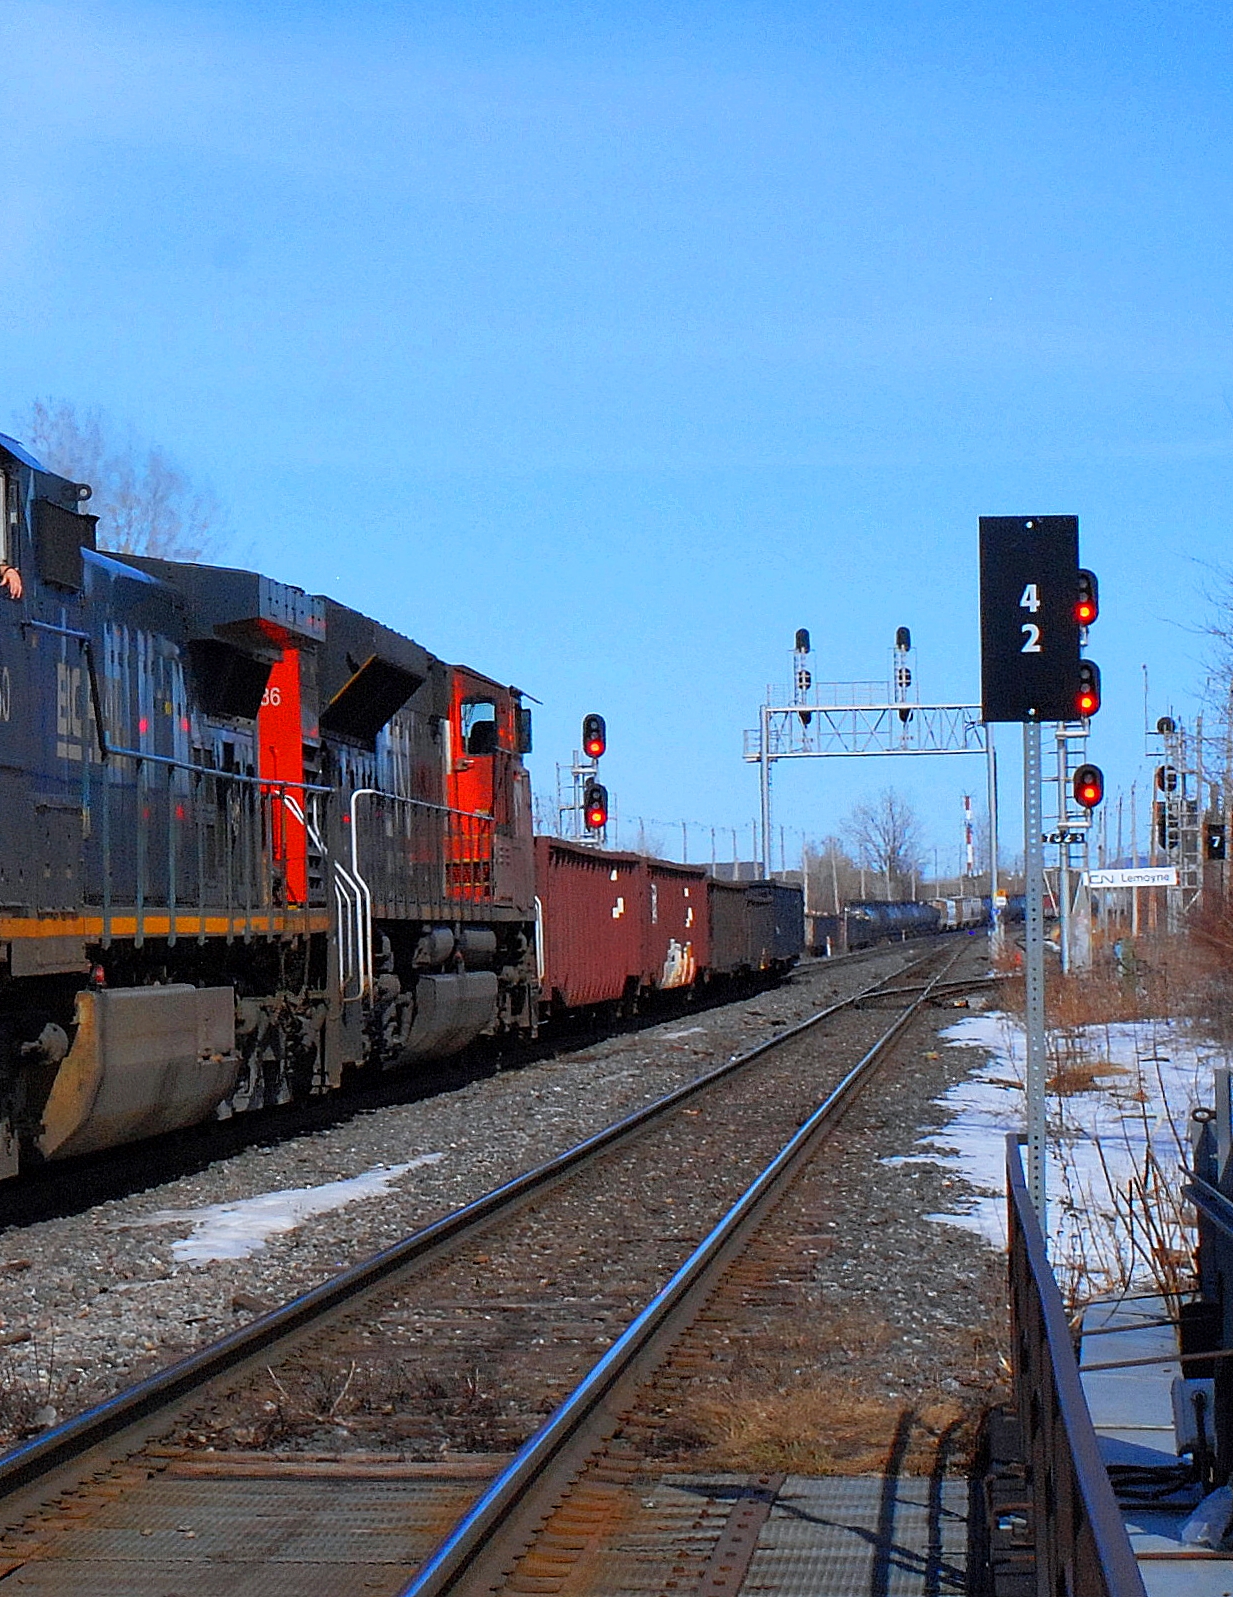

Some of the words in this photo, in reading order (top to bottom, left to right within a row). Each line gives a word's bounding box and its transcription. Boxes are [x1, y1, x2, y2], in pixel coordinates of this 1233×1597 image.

[1019, 583, 1041, 613] 4
[1020, 623, 1042, 653] 2
[1211, 835, 1221, 848] 7
[1089, 874, 1114, 884] CN
[1121, 873, 1170, 883] Lemoyne
